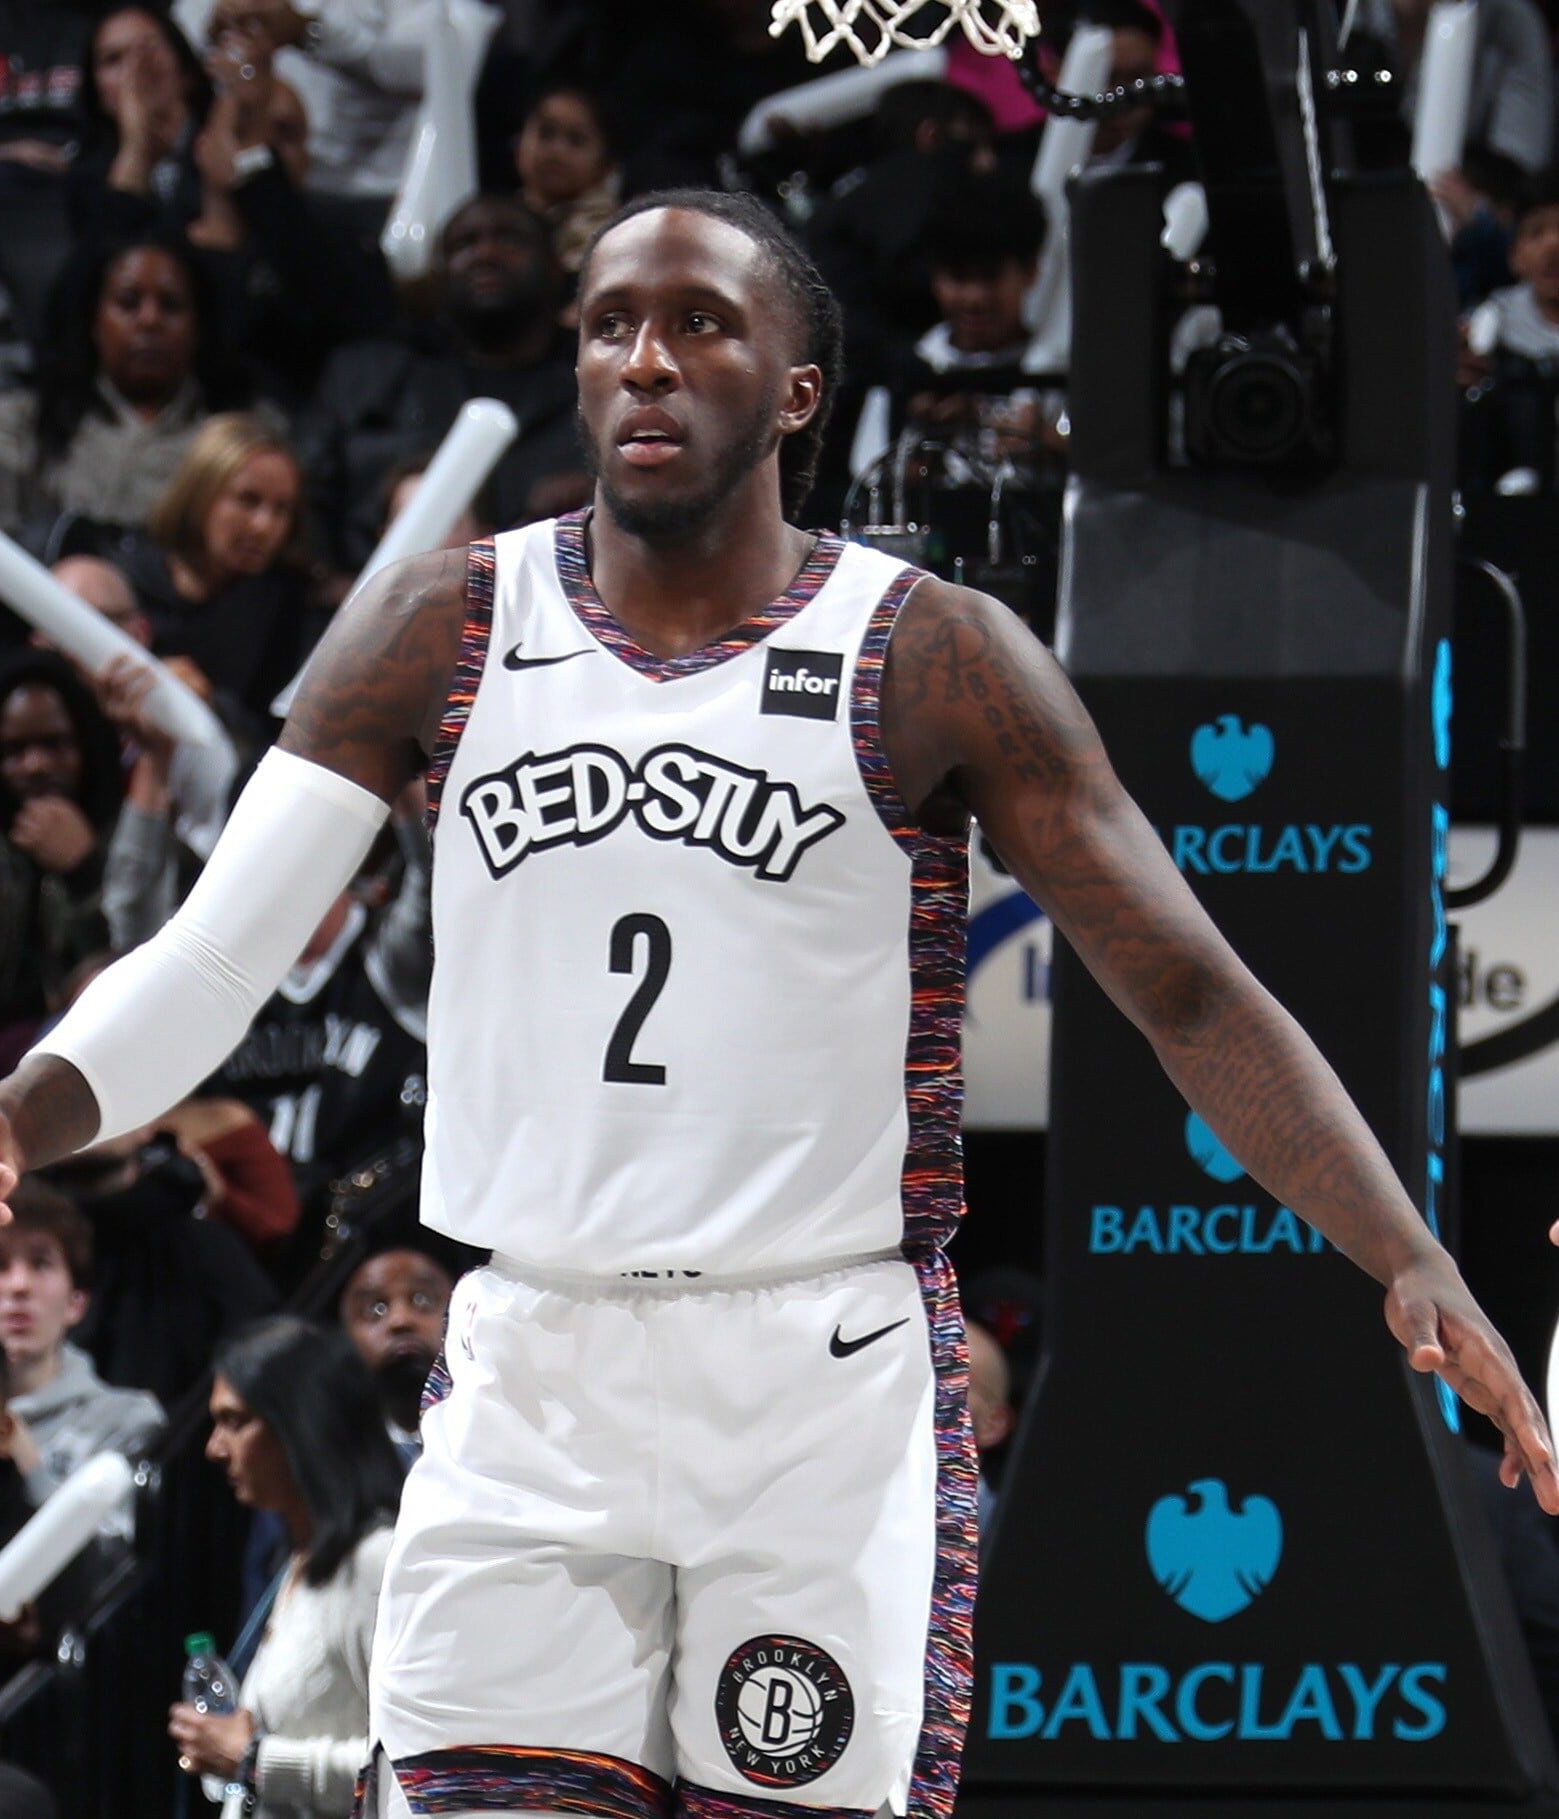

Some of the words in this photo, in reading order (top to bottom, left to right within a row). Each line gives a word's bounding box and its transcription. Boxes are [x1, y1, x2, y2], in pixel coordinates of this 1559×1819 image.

[768, 668, 838, 695] infor
[459, 742, 846, 881] BED-STUY
[1154, 824, 1373, 875] RCLAYS
[602, 912, 672, 1085] 2
[1089, 1204, 1325, 1255] BARCLA
[732, 1649, 838, 1702] BROOKLYN
[761, 1677, 793, 1745] B
[987, 1663, 1447, 1742] BARCLAYS
[729, 1727, 760, 1766] NEW
[771, 1745, 825, 1774] YORK
